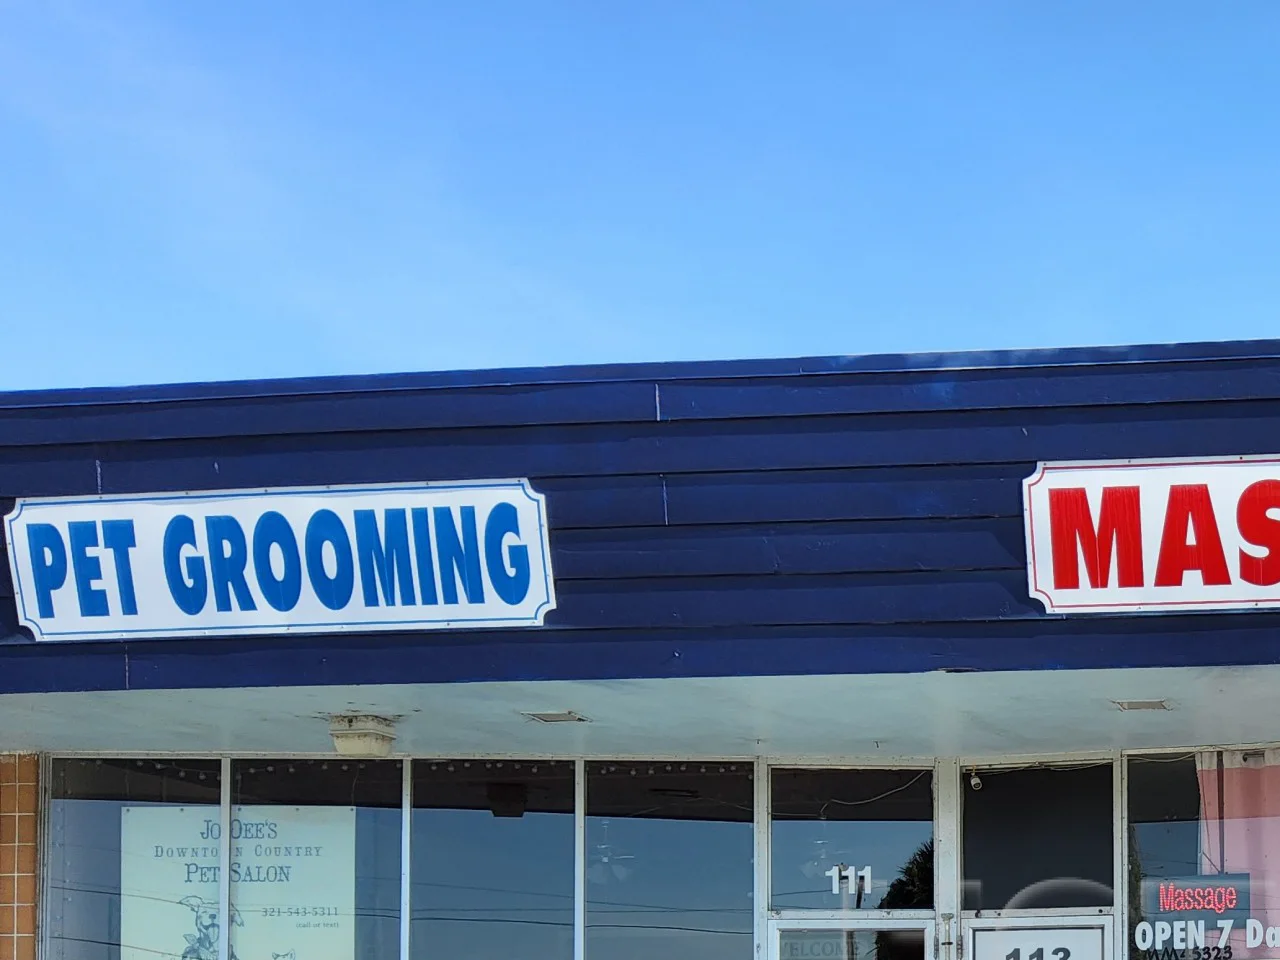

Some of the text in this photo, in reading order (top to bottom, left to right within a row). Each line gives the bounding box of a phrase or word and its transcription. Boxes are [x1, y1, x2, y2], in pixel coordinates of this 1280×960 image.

[26, 502, 530, 618] PET GROOMING
[154, 844, 324, 858] DOWNTON COUNTRY
[184, 863, 291, 883] PET SALON
[825, 865, 872, 894] 111
[1159, 882, 1237, 914] Massage
[261, 906, 339, 917] 321-543-5311
[296, 920, 311, 929] (call
[1135, 921, 1205, 950] OPEN
[1217, 919, 1234, 949] 7
